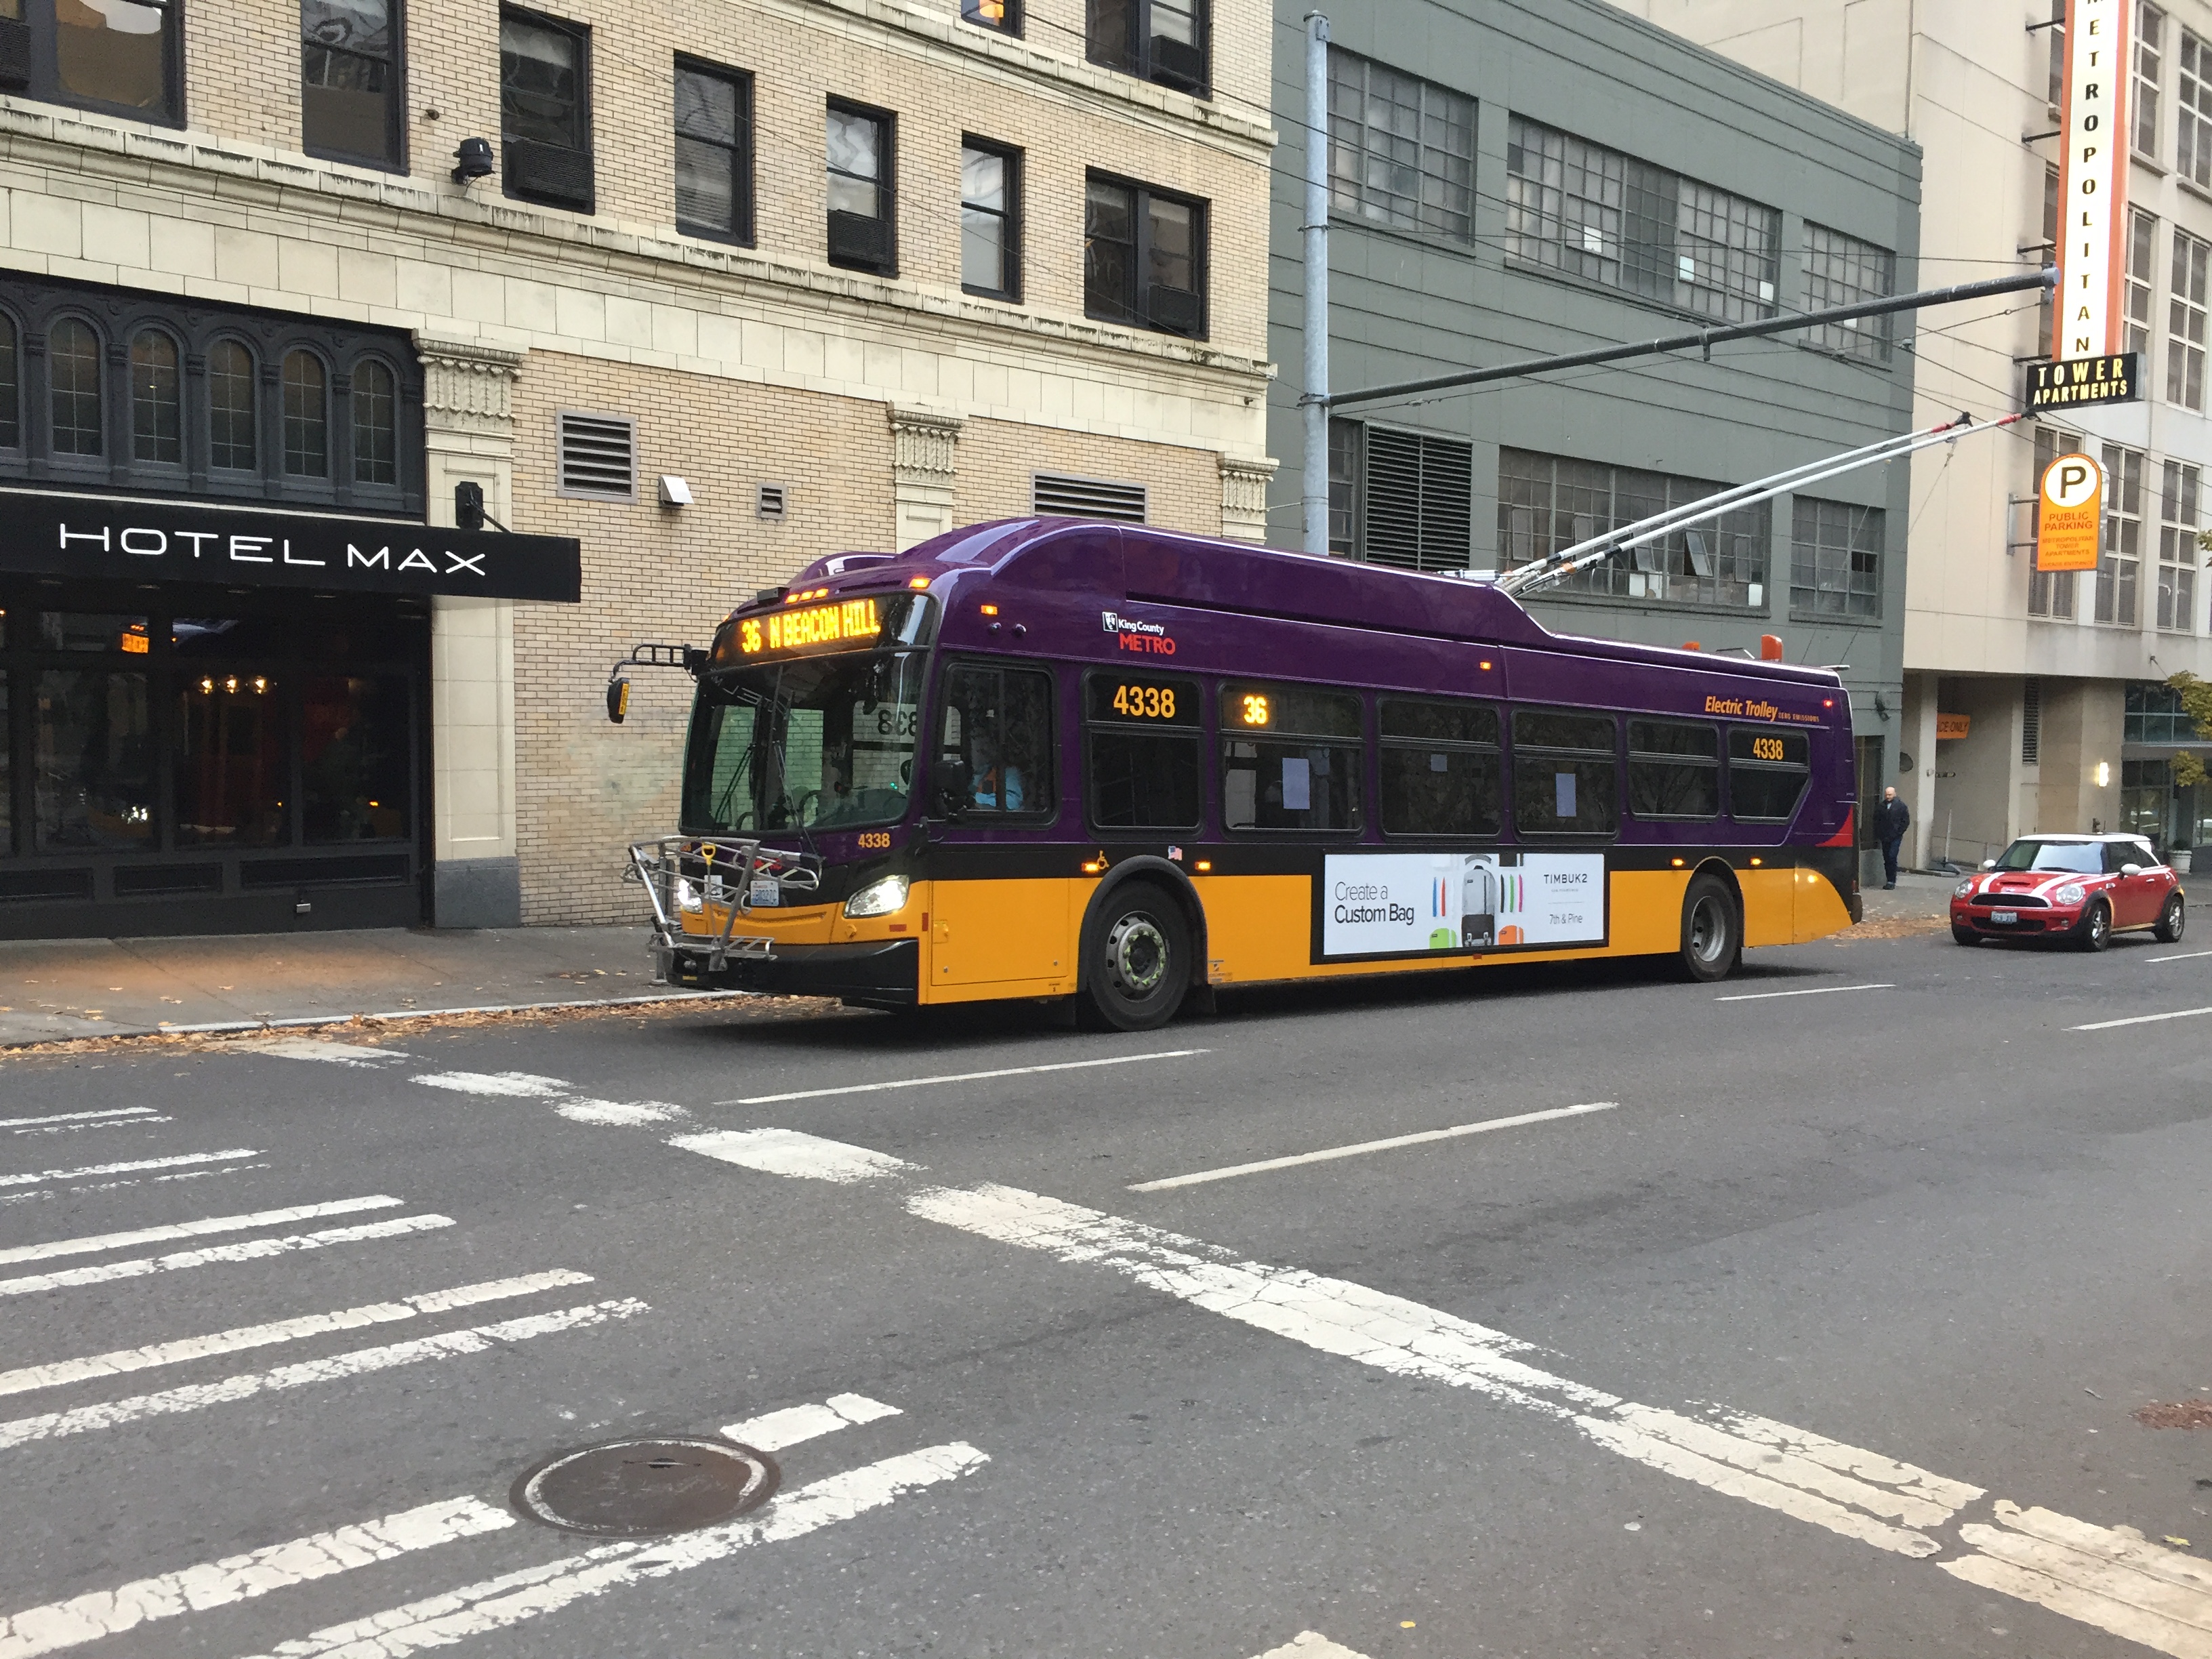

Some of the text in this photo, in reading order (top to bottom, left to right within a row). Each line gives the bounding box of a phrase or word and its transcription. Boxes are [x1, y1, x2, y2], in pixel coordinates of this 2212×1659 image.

[2076, 0, 2103, 352] ETROPOLITAN
[2038, 358, 2123, 387] TOWER
[2033, 380, 2127, 405] APARTMENTS
[2060, 466, 2087, 499] P
[2044, 520, 2093, 531] PARKING
[2049, 511, 2089, 522] PUBLIC
[60, 523, 486, 576] HOTEL MAX
[741, 598, 881, 653] 36 N BEACON HILL
[1118, 618, 1164, 636] King County
[1119, 632, 1176, 655] METRO
[1113, 684, 1175, 718] 4338
[1243, 695, 1267, 724] 36
[1704, 695, 1743, 715] Electric
[1746, 699, 1779, 722] Trolley
[1753, 737, 1784, 760] 4338
[858, 832, 890, 848] 4338
[1544, 874, 1588, 884] TIMBUK2
[1334, 881, 1388, 901] Create a
[1334, 903, 1414, 926] Custom Bag
[1549, 913, 1583, 924] 7th & Pine
